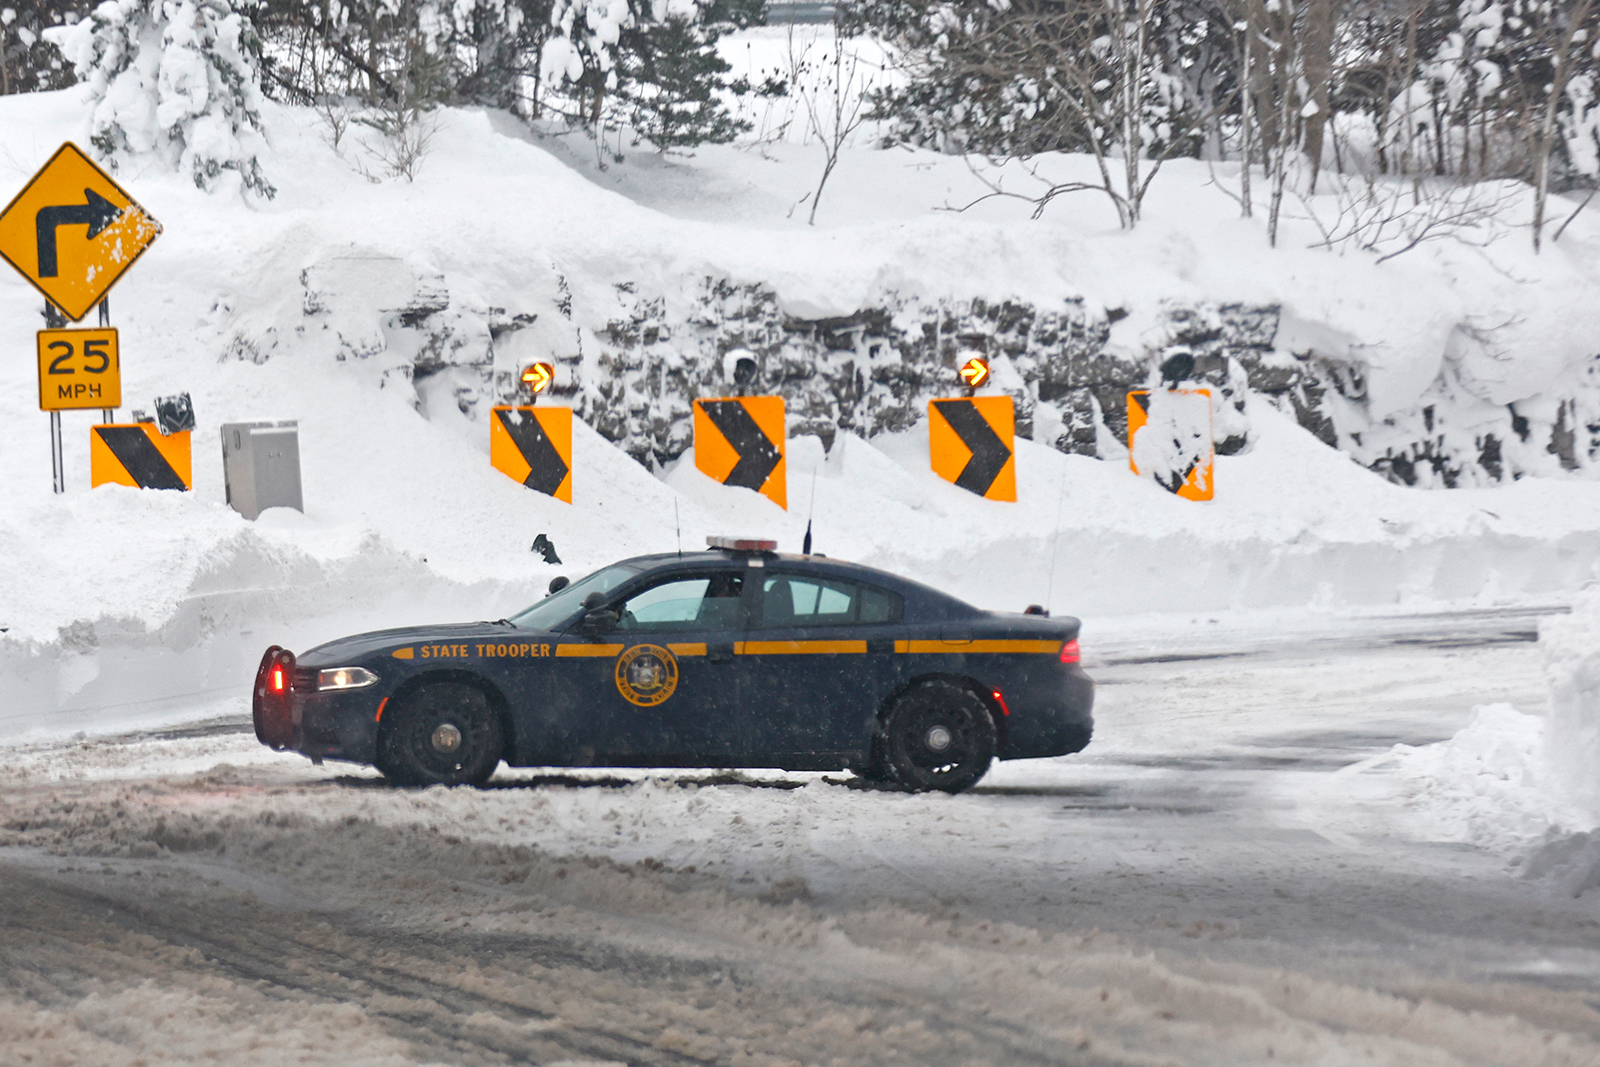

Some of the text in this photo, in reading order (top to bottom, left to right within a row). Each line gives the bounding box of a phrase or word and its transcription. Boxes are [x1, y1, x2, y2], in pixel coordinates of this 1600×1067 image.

[48, 340, 110, 375] 25
[58, 383, 102, 399] MPH
[421, 643, 551, 658] STATE TROOPER
